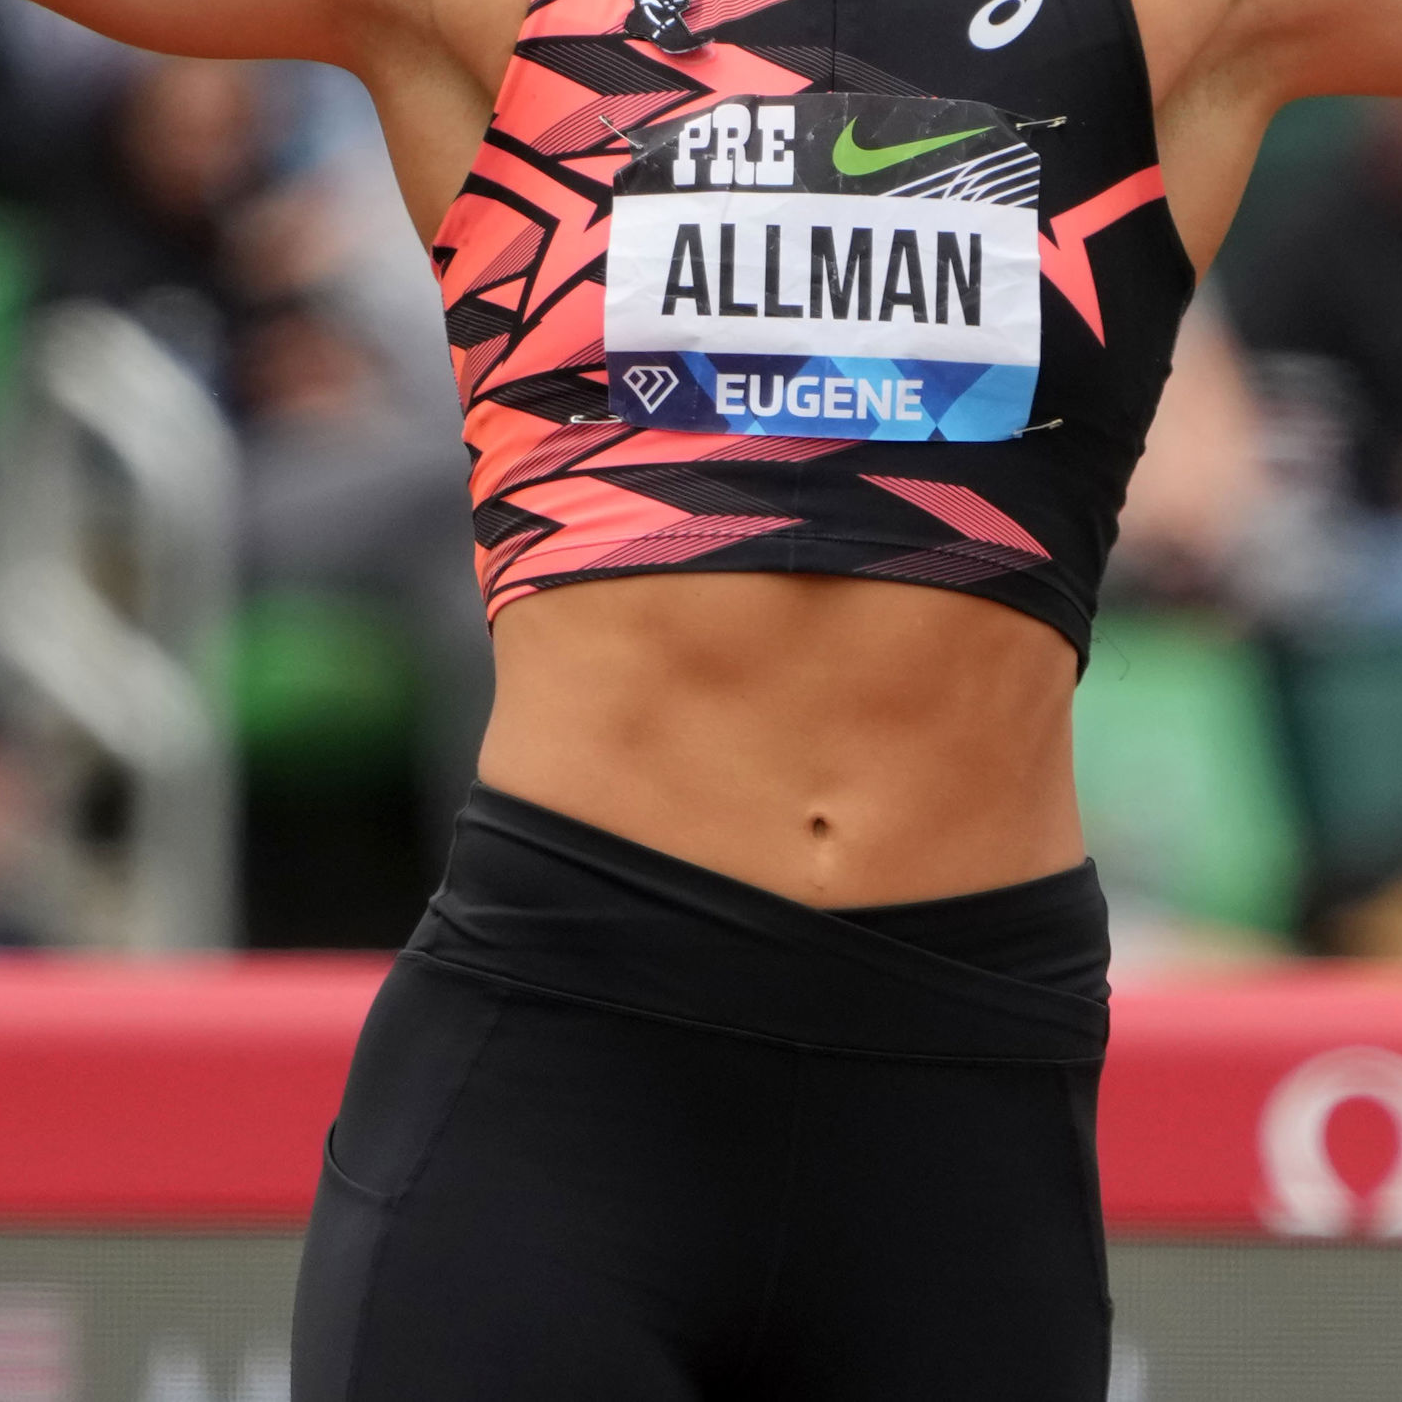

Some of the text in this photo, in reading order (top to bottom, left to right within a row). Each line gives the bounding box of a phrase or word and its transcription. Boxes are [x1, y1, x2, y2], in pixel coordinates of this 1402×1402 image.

[672, 104, 795, 188] PRE
[661, 222, 982, 327] ALLMAN
[714, 372, 923, 422] EUGENE
